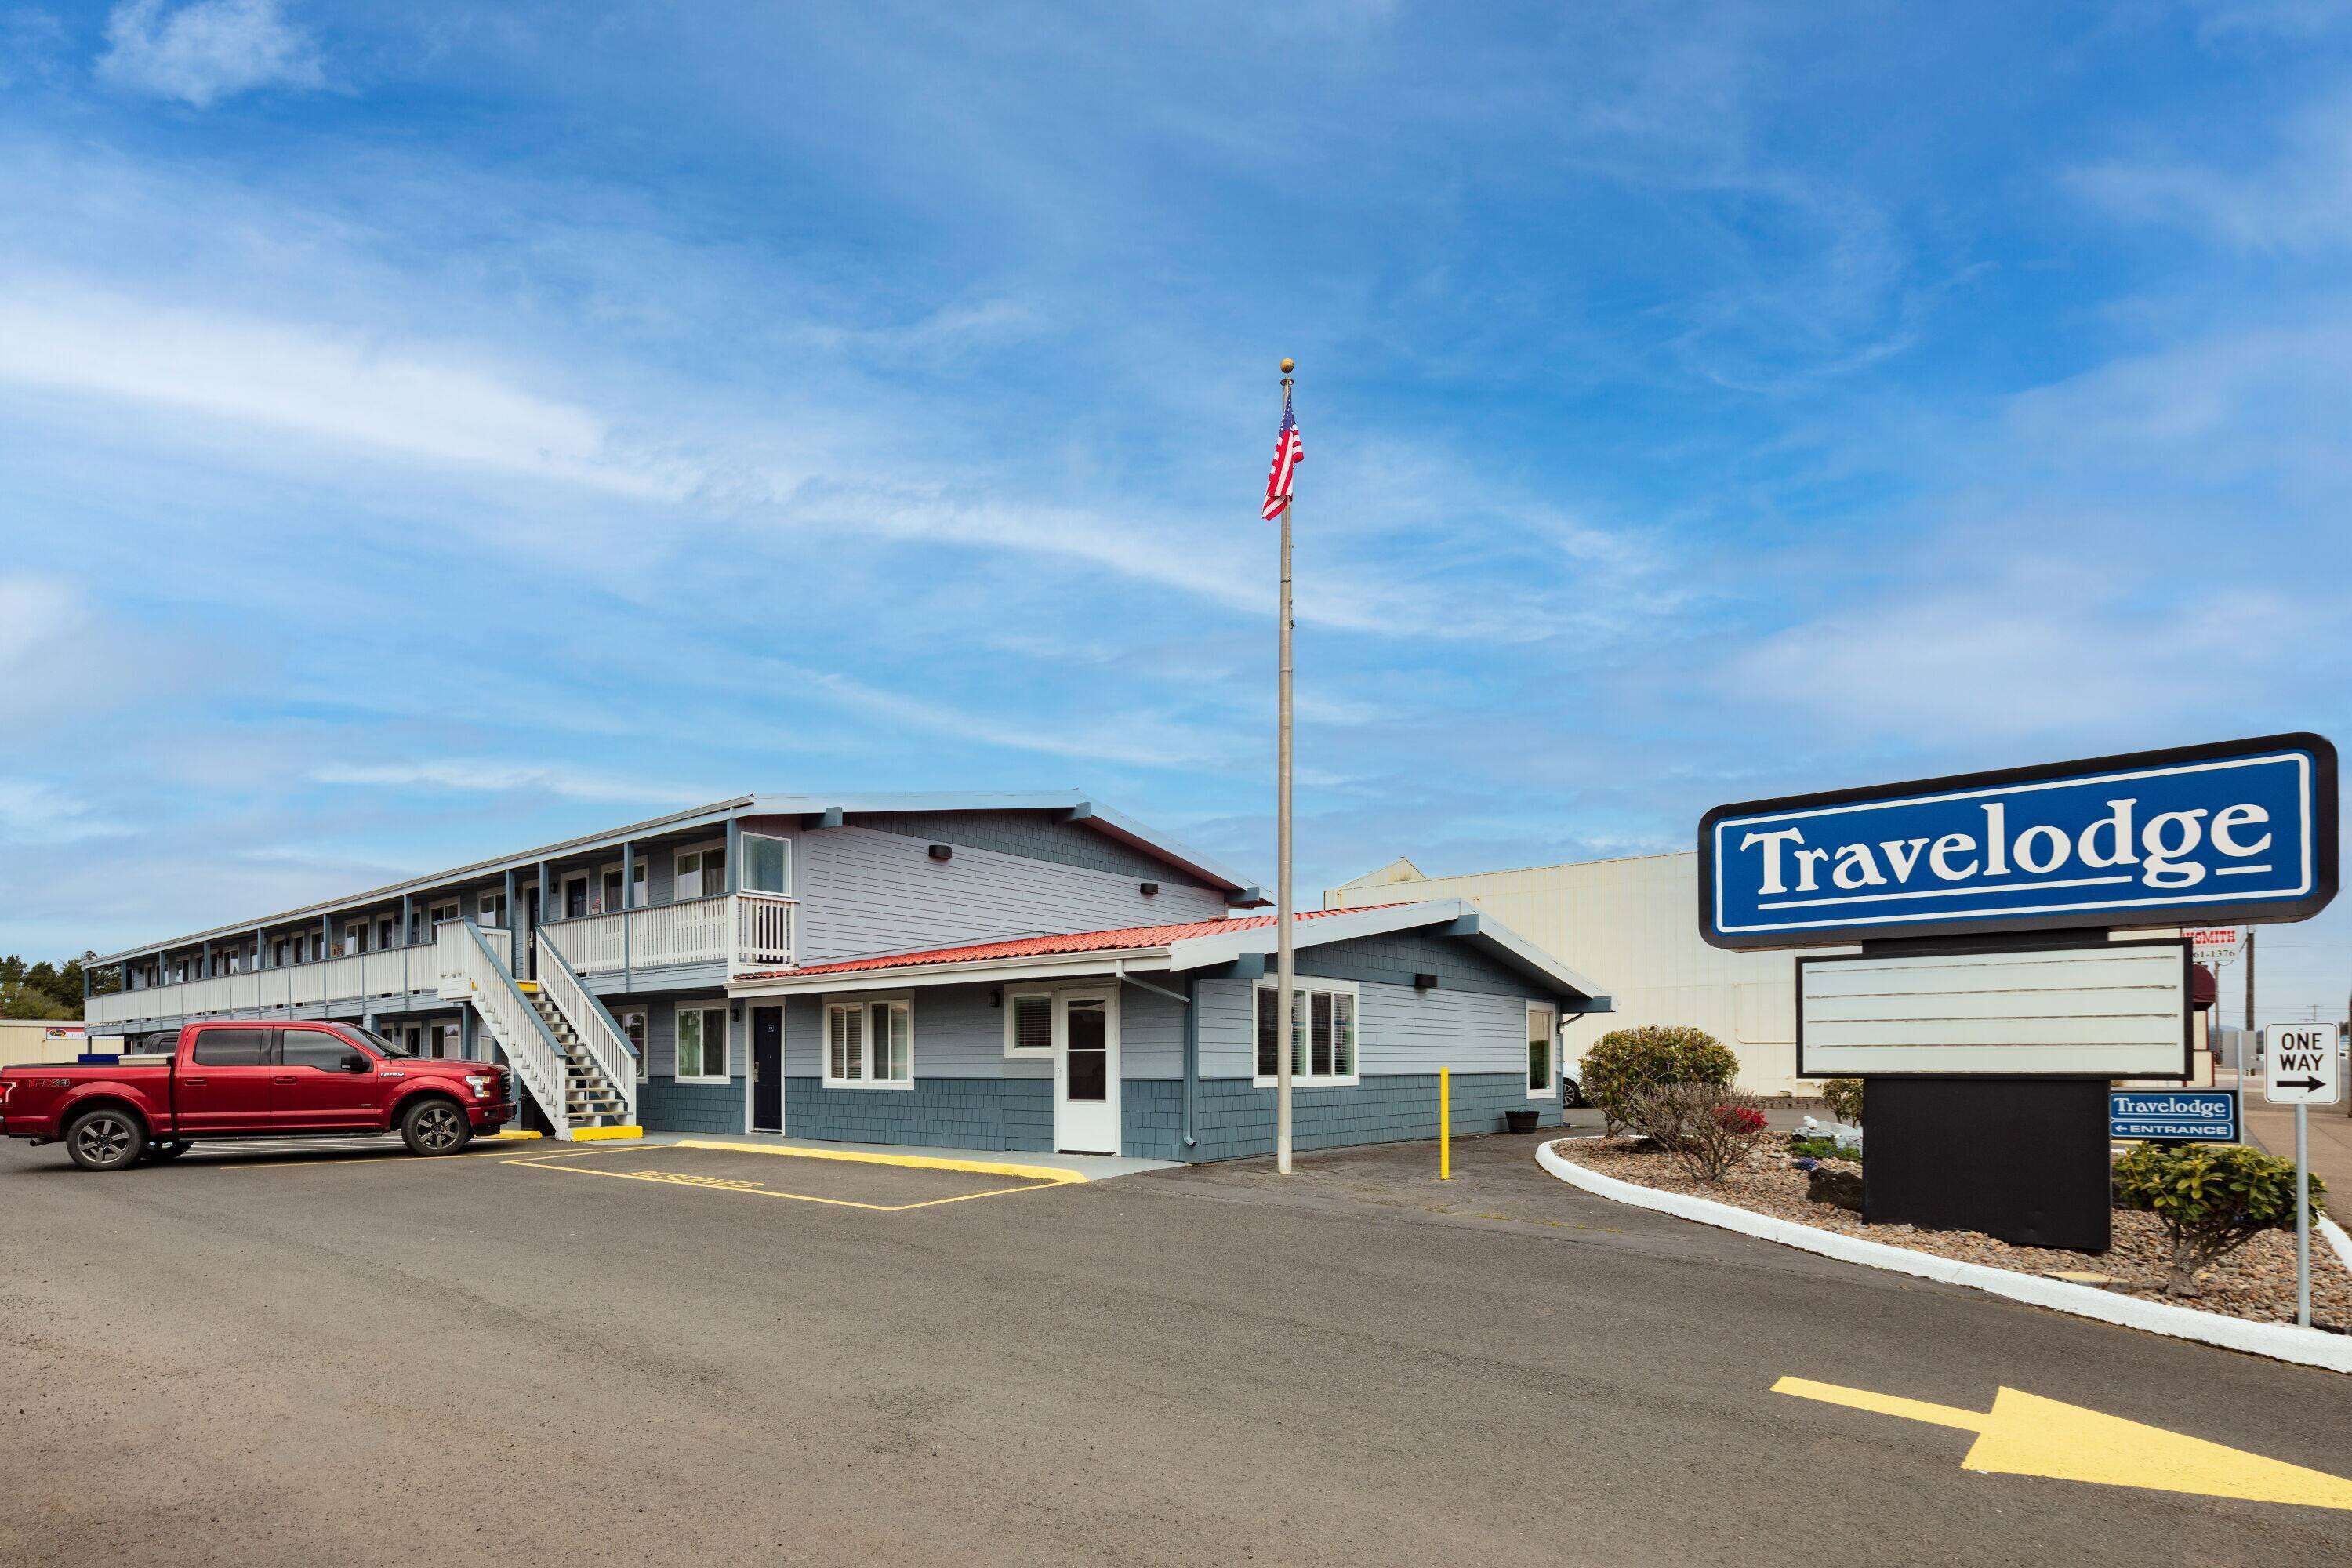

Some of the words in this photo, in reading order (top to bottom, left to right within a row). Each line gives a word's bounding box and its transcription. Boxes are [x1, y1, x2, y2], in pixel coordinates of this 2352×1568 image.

[1740, 798, 2272, 895] Travelodge
[2183, 930, 2236, 944] SMITH
[2281, 1033, 2323, 1051] ONE
[2279, 1054, 2324, 1071] WAY
[2113, 1097, 2226, 1118] Travelodge
[2129, 1125, 2227, 1134] ENTRANCE
